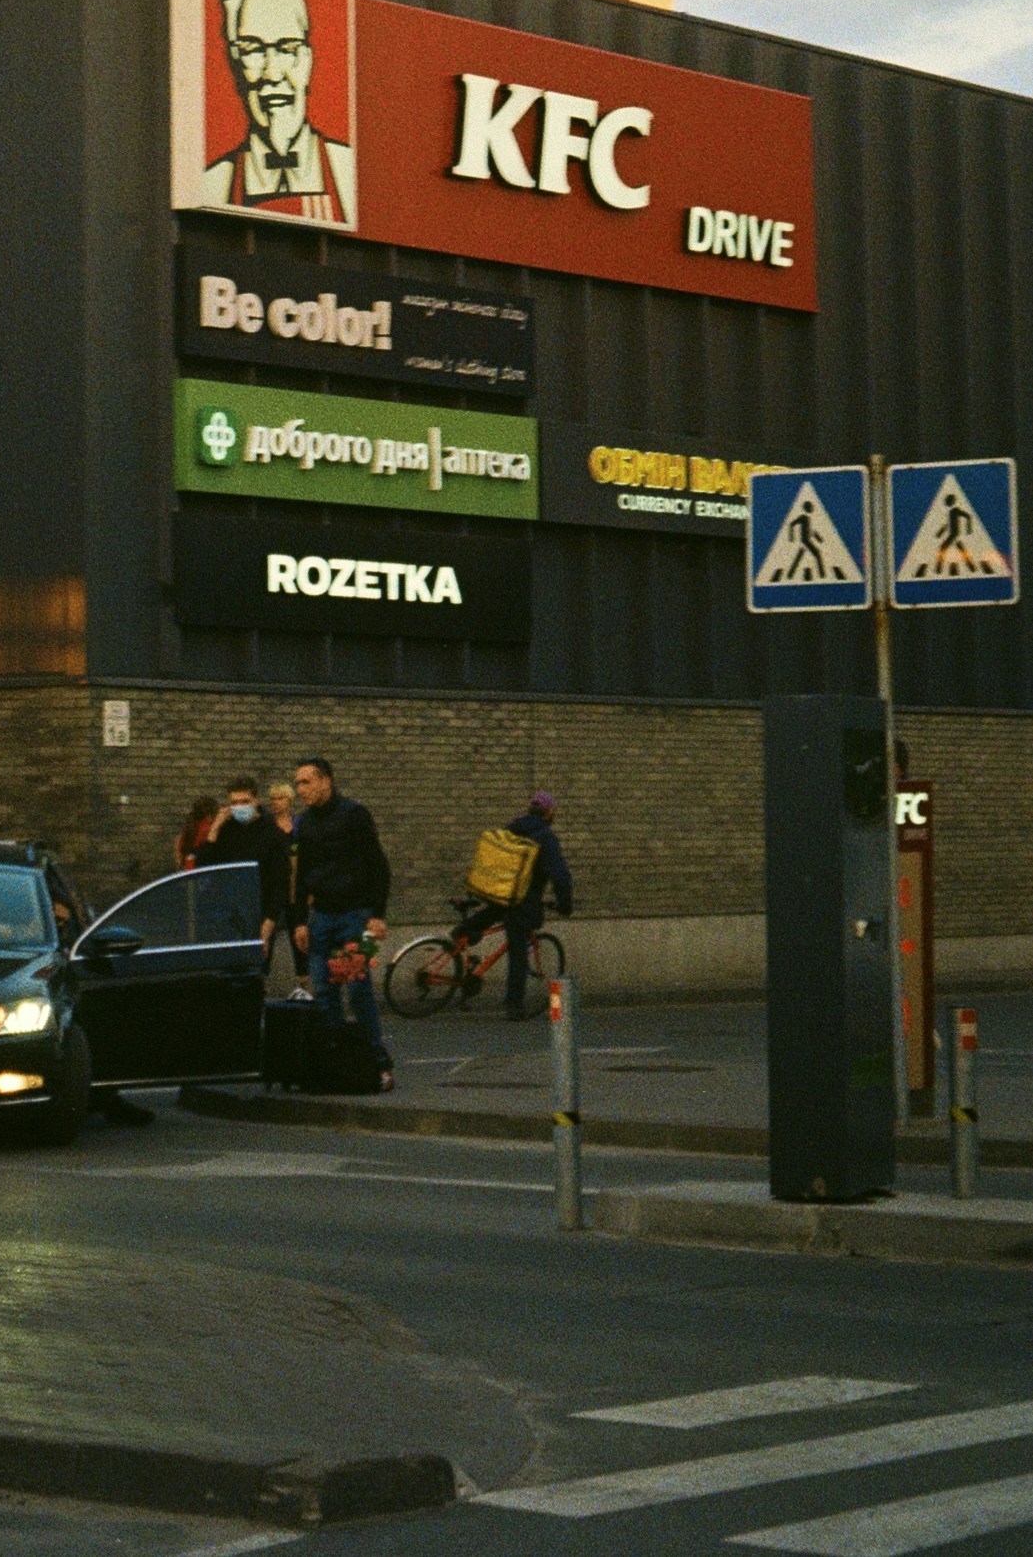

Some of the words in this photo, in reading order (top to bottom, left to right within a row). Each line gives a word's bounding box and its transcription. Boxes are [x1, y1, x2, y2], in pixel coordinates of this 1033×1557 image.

[452, 73, 654, 210] KFC
[687, 206, 795, 268] DRIVE
[200, 275, 264, 333] Be
[268, 293, 393, 351] color!
[243, 418, 372, 470] доброго
[371, 439, 429, 475] дня
[442, 446, 531, 481] аптека
[618, 494, 693, 515] CURRENCY
[694, 500, 751, 520] EXCHAN
[267, 554, 463, 605] ROZETKA
[894, 792, 929, 825] FC
